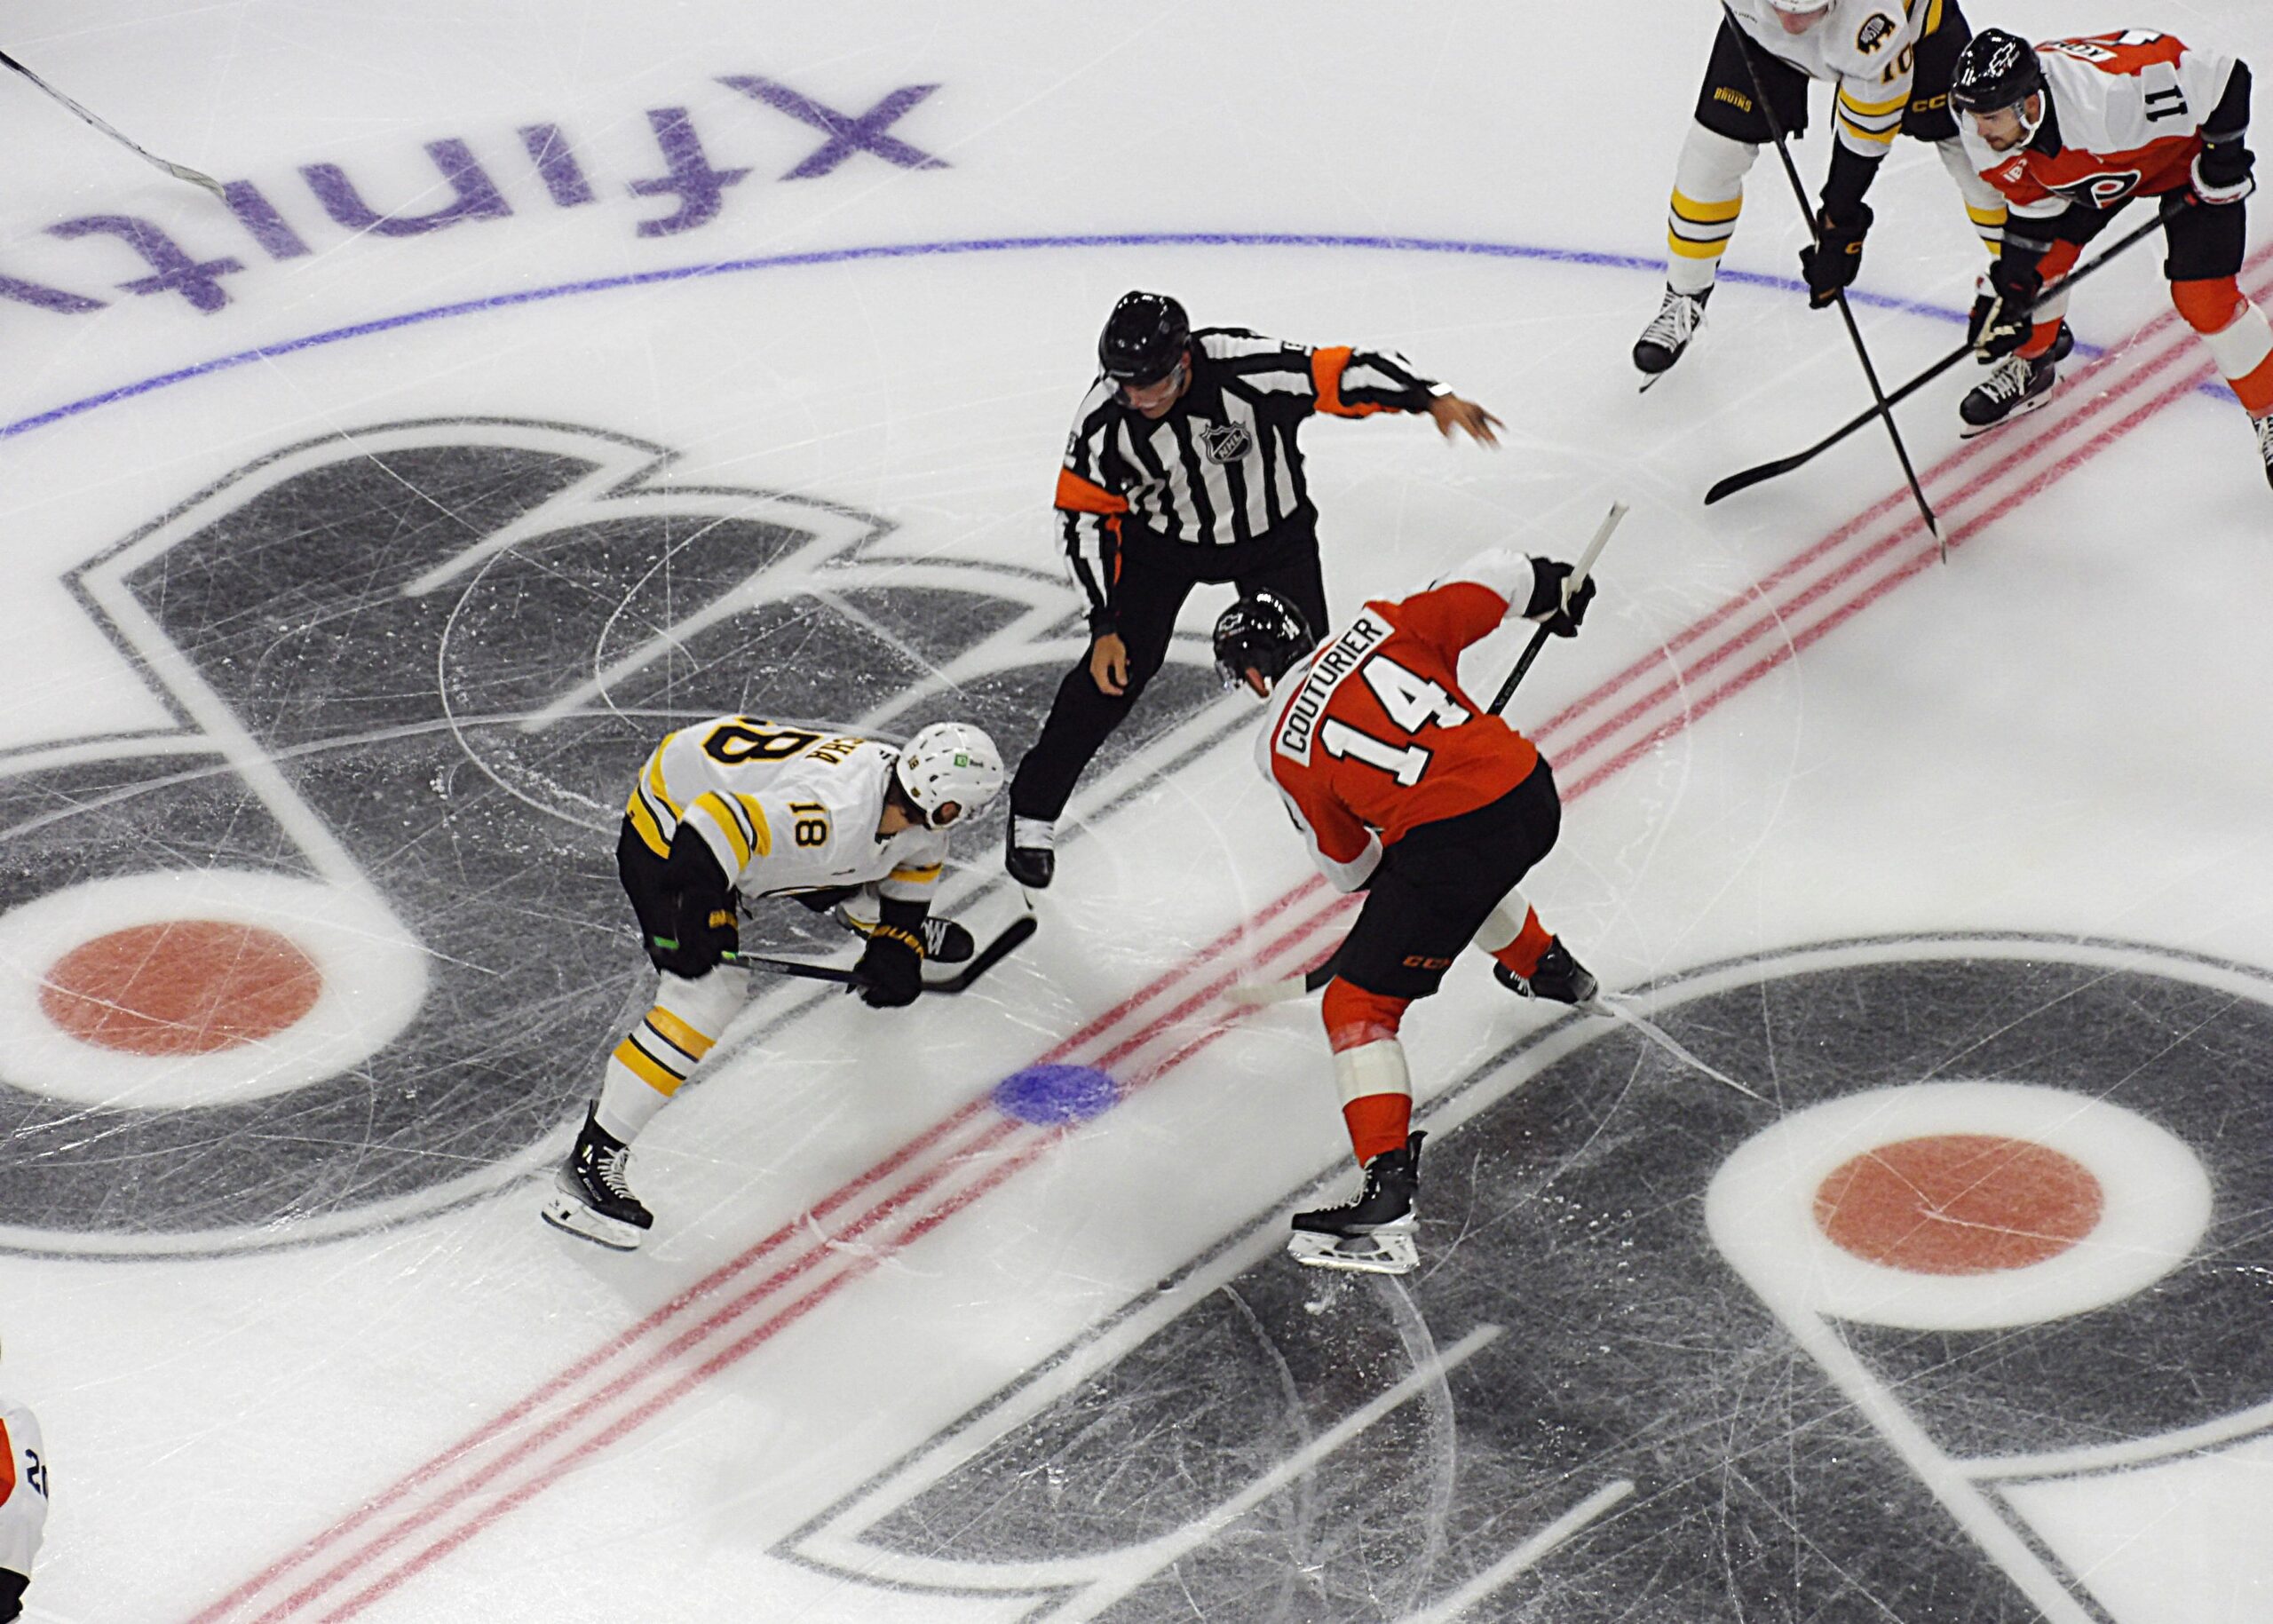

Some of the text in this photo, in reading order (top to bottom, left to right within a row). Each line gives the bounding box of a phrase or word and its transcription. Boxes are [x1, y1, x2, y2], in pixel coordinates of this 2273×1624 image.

[1714, 87, 1753, 113] BRUINS
[1912, 93, 1946, 113] CC
[2144, 85, 2188, 123] 11
[1217, 432, 1242, 459] NHL
[1282, 617, 1383, 754] COUTURIER
[701, 716, 824, 766] 8
[1319, 653, 1474, 788] 14
[788, 801, 829, 847] 18
